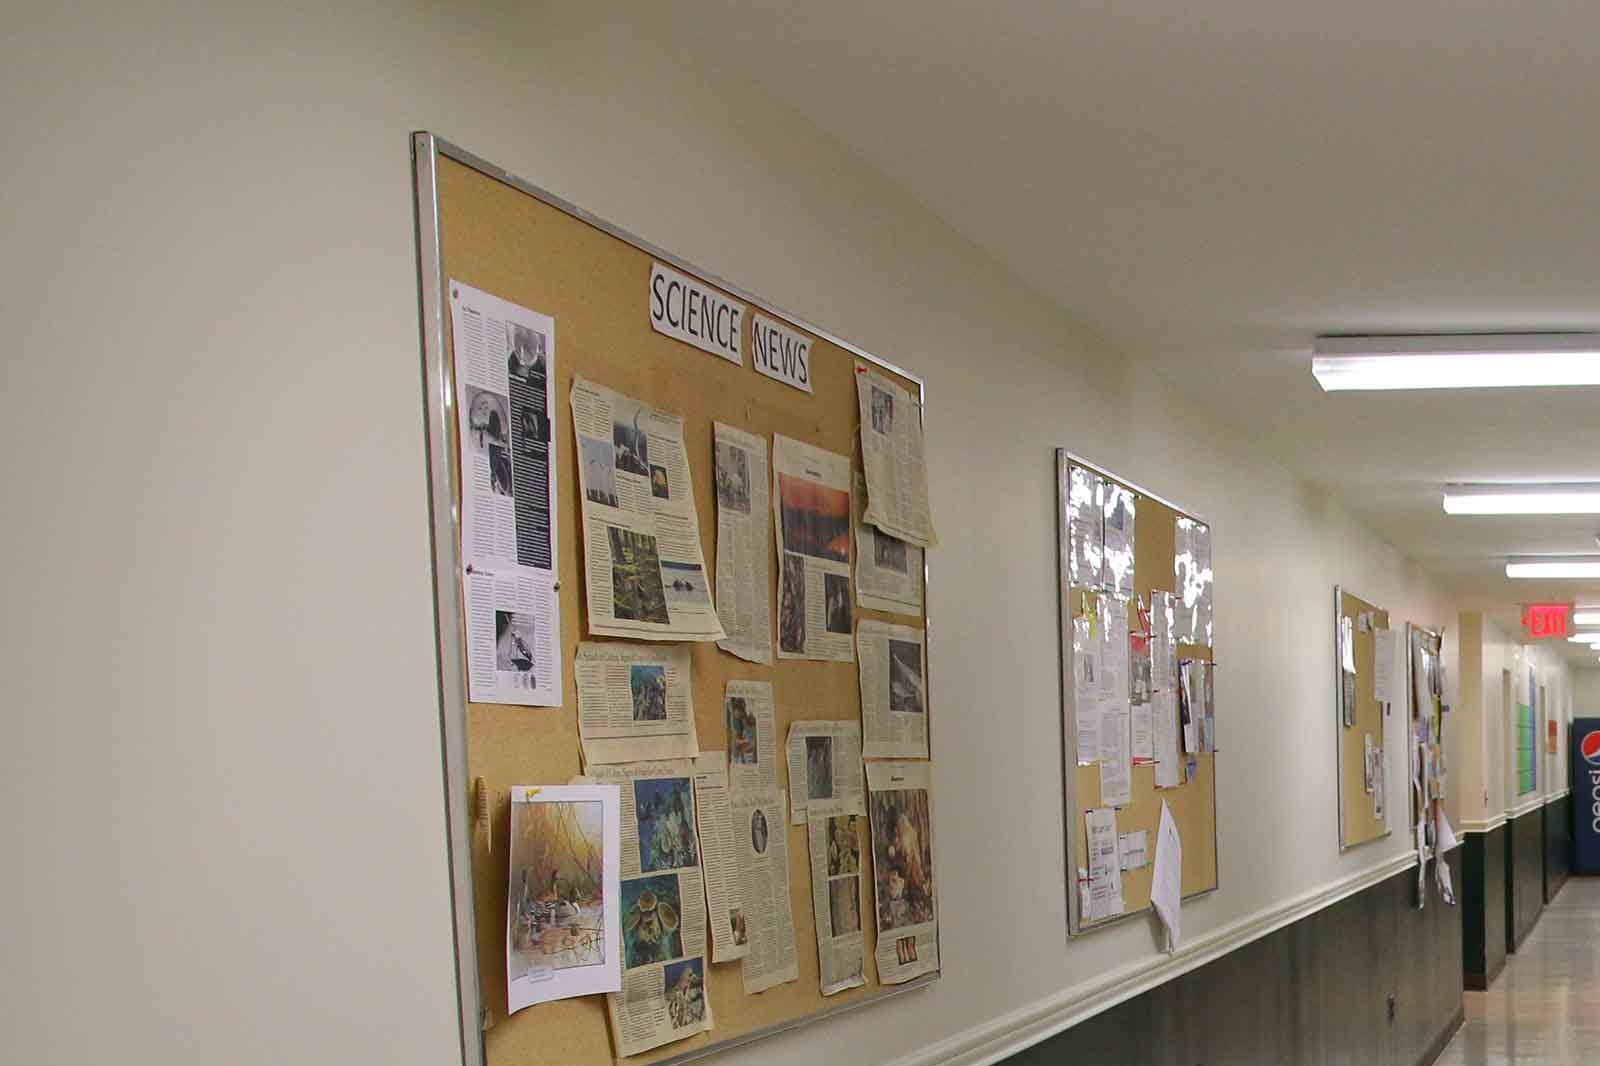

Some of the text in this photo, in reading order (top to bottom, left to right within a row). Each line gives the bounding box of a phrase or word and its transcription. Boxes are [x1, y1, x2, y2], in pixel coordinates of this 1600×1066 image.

[653, 274, 807, 384] SCIENCE NEWS
[1531, 607, 1566, 635] EXIT
